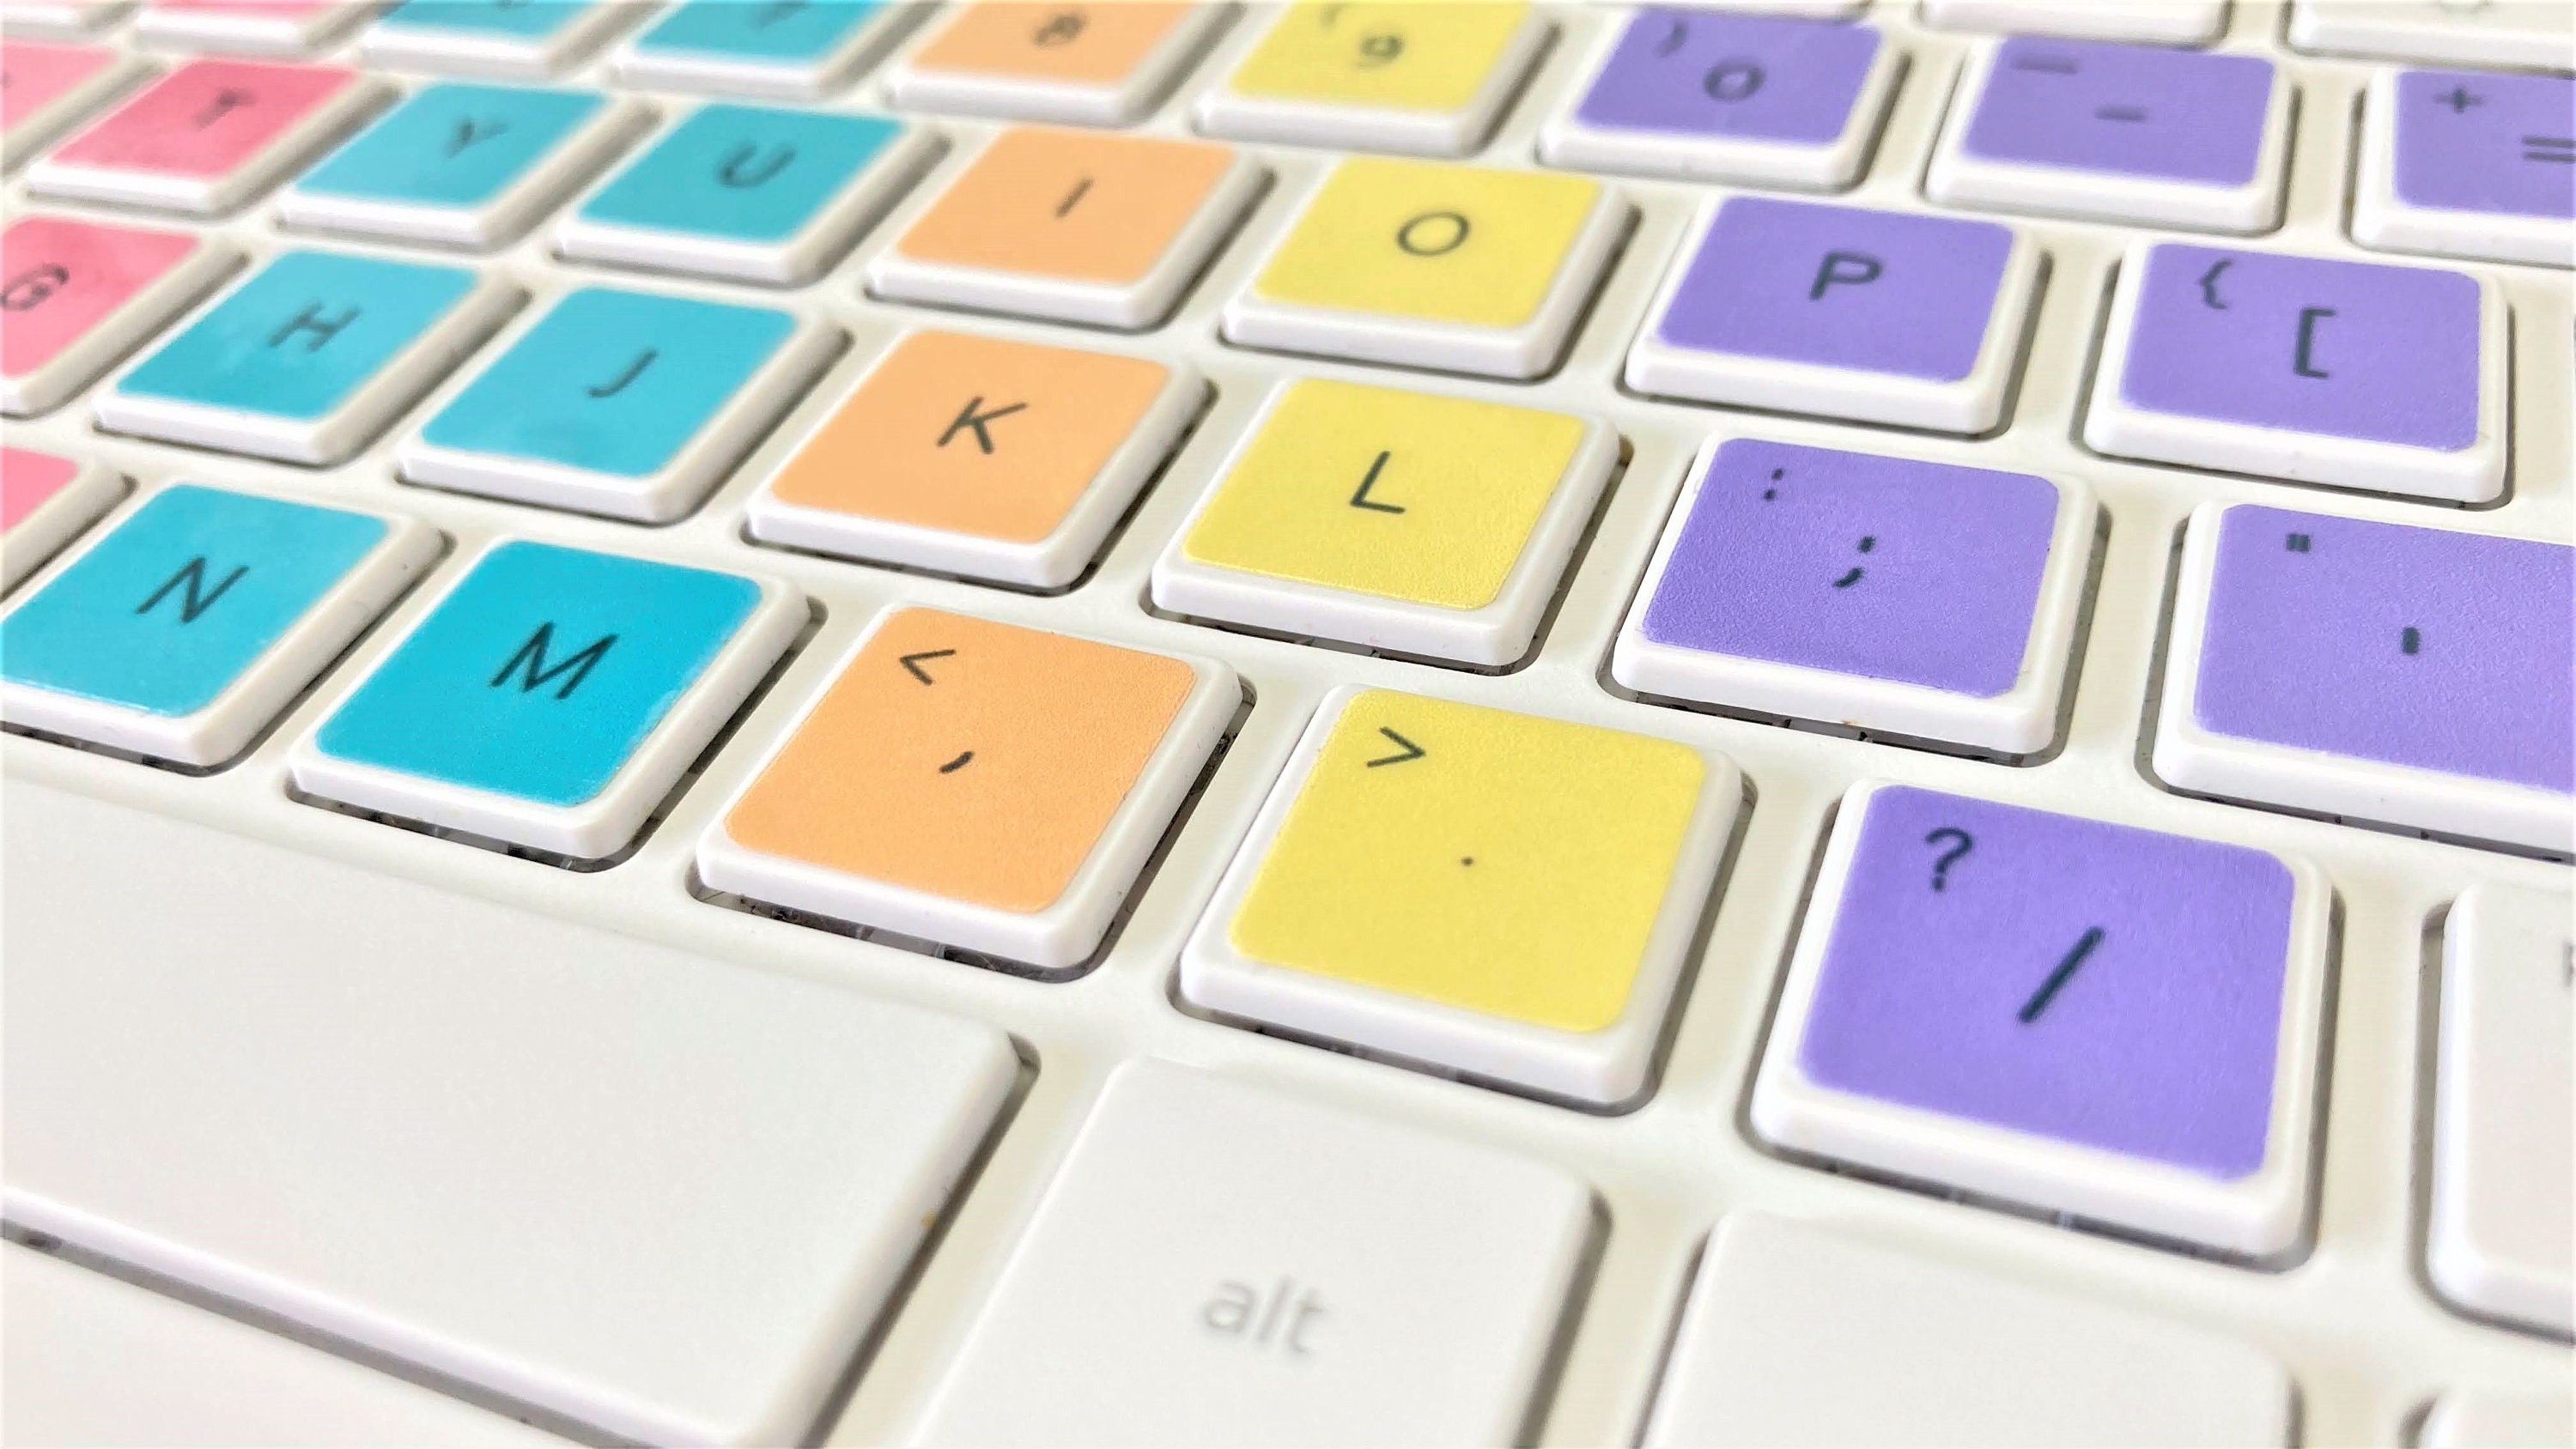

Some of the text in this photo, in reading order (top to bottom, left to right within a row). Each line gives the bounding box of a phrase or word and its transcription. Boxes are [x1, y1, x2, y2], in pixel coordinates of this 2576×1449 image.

[444, 117, 509, 158] Y
[716, 146, 796, 188] U
[0, 263, 70, 310] G
[1809, 251, 1884, 300] P
[264, 303, 360, 353] H
[2293, 306, 2336, 379] [
[587, 349, 659, 398] J
[937, 397, 1027, 454] K
[1350, 451, 1406, 514] L
[1832, 537, 1875, 589] ;
[135, 556, 249, 624] N
[490, 622, 618, 700] M
[899, 649, 957, 686] <
[1366, 727, 1425, 767] >
[1925, 827, 1974, 892] ?
[2017, 927, 2105, 1025] /
[1200, 1277, 1327, 1358] alt
